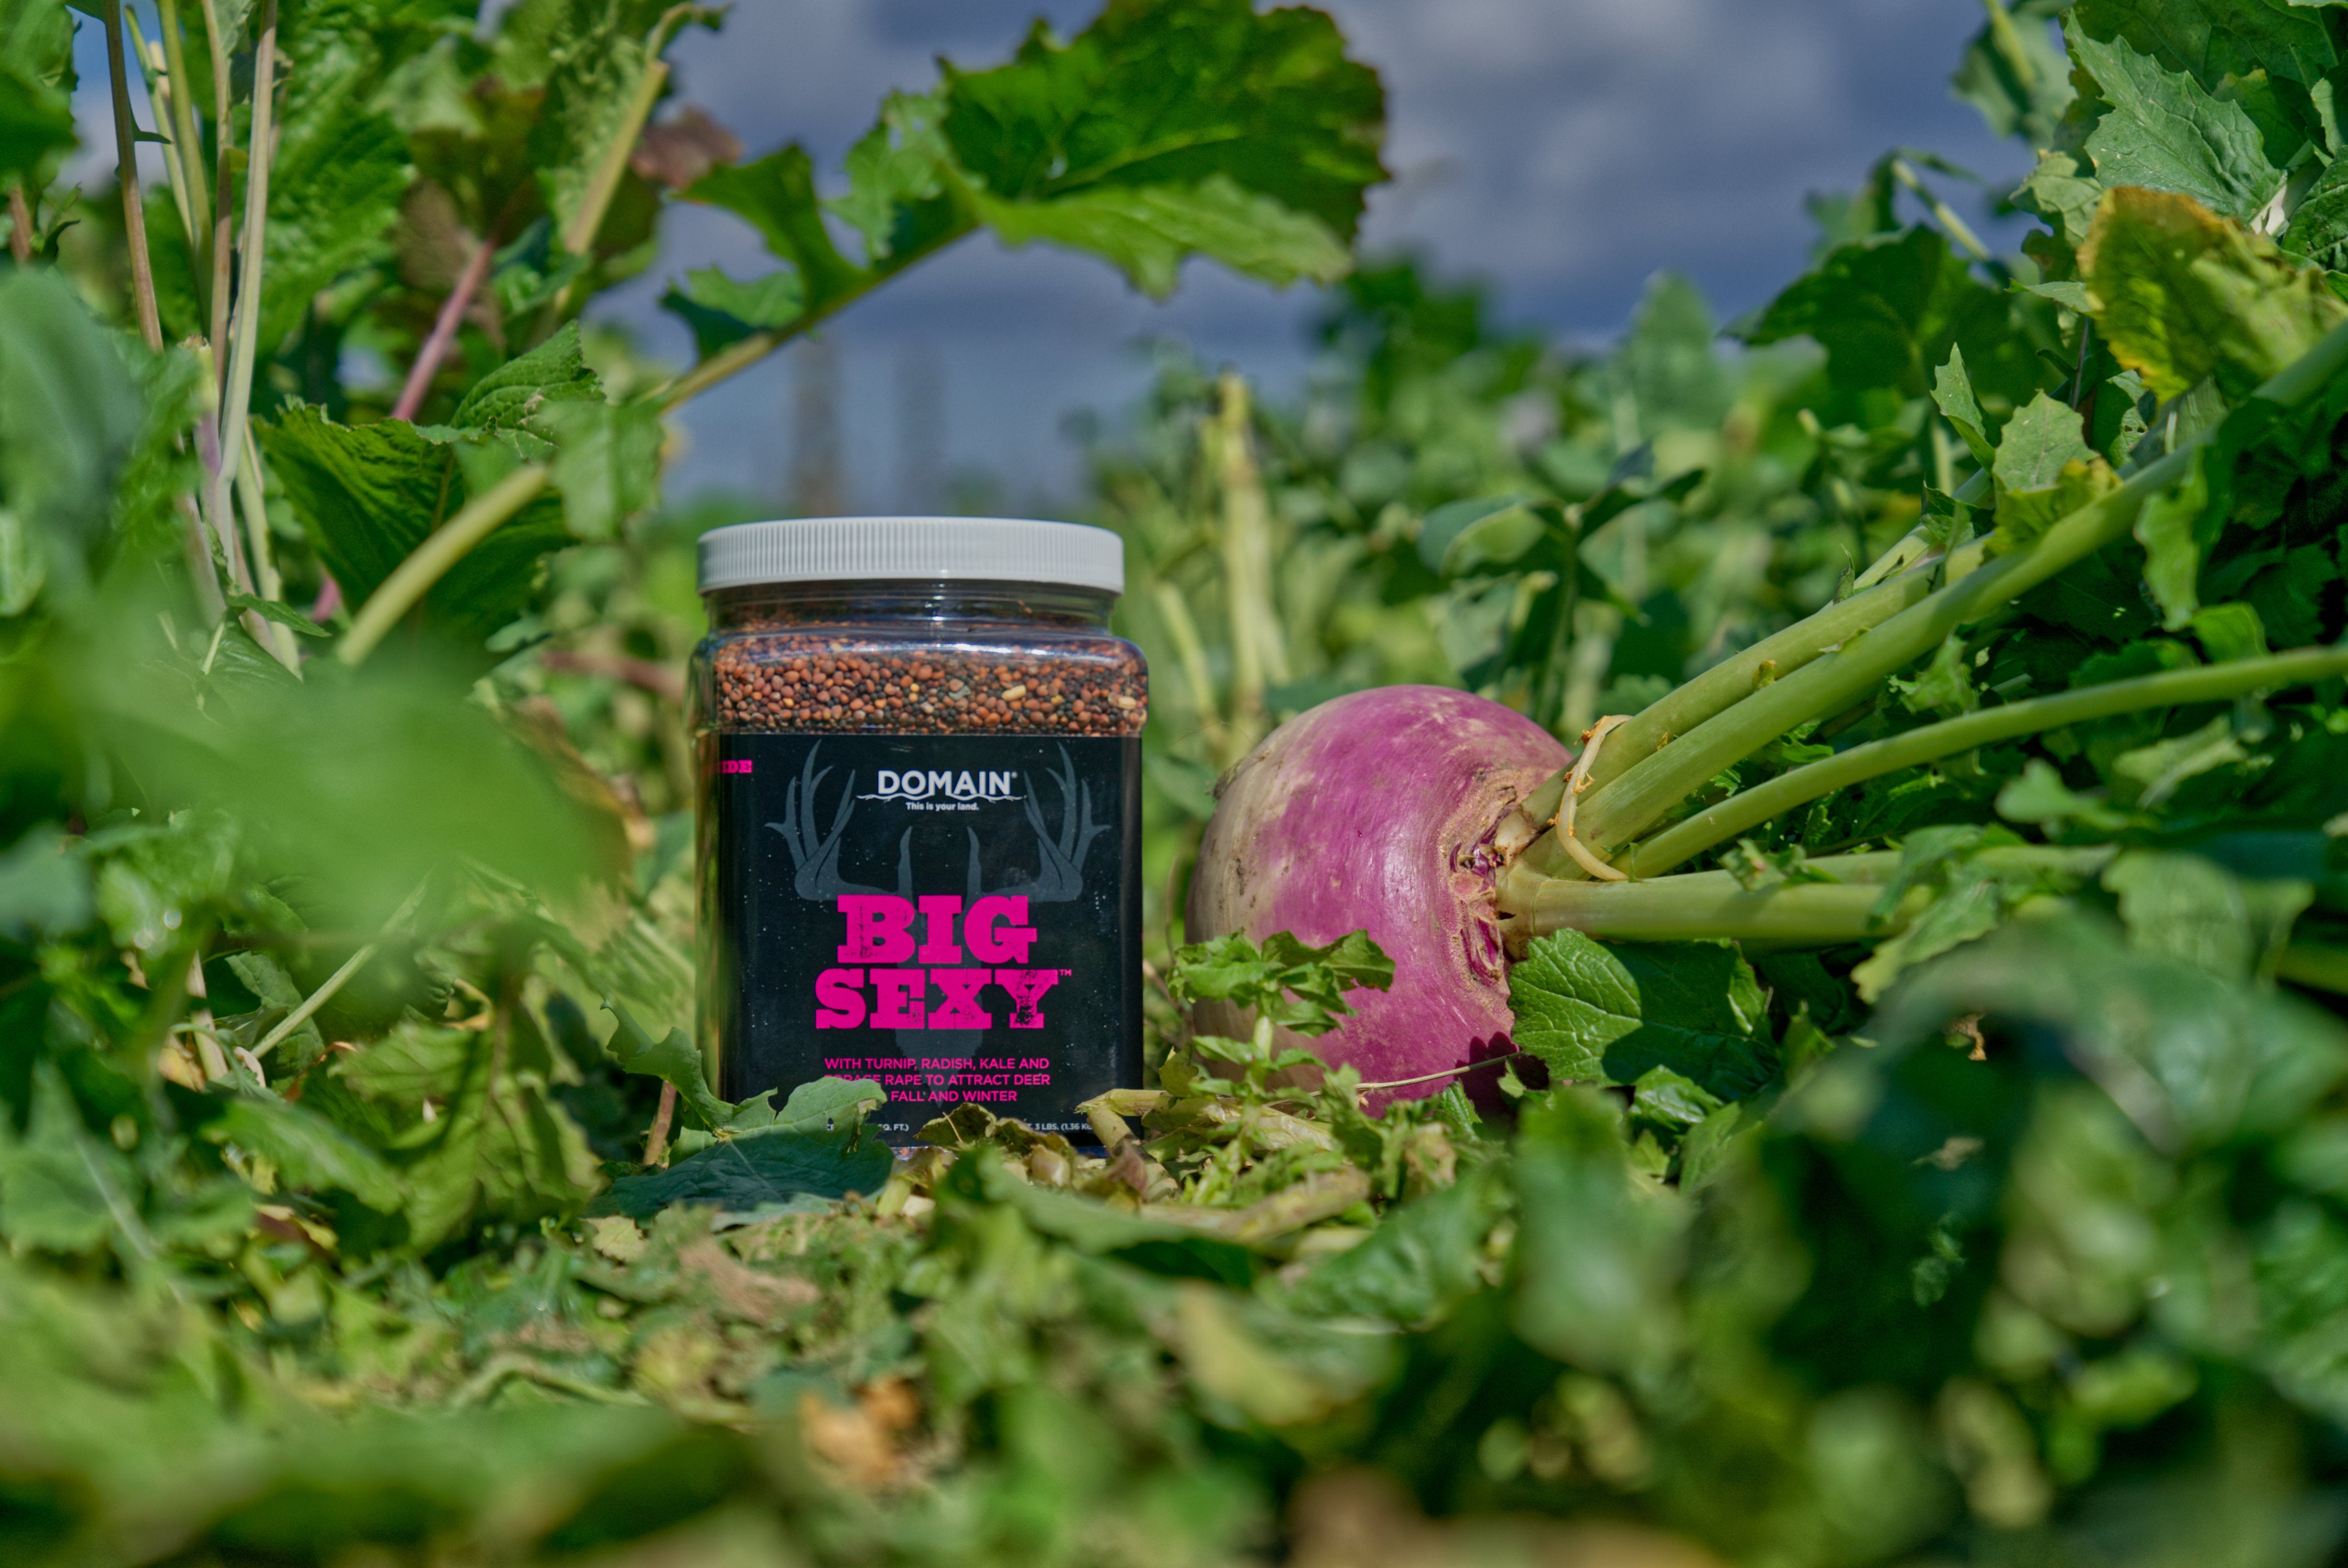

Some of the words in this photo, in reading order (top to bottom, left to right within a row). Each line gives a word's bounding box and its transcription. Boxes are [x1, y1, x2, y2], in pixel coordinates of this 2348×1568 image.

[957, 802, 979, 810] land.
[837, 894, 1037, 964] BIG
[824, 1058, 862, 1069] WITH
[865, 1058, 918, 1071] TURNIP,
[921, 1058, 976, 1070] RADISH,
[979, 1058, 1016, 1069] KALE
[1019, 1058, 1050, 1069] AND
[885, 1074, 922, 1086] RAPE
[925, 1074, 945, 1086] TO
[948, 1074, 1011, 1086] ATTRACT
[1014, 1074, 1051, 1086] DEER
[890, 1090, 925, 1102] FALL
[927, 1090, 959, 1102] AND
[962, 1090, 1018, 1102] WINTER
[1060, 1123, 1080, 1132] (1.36
